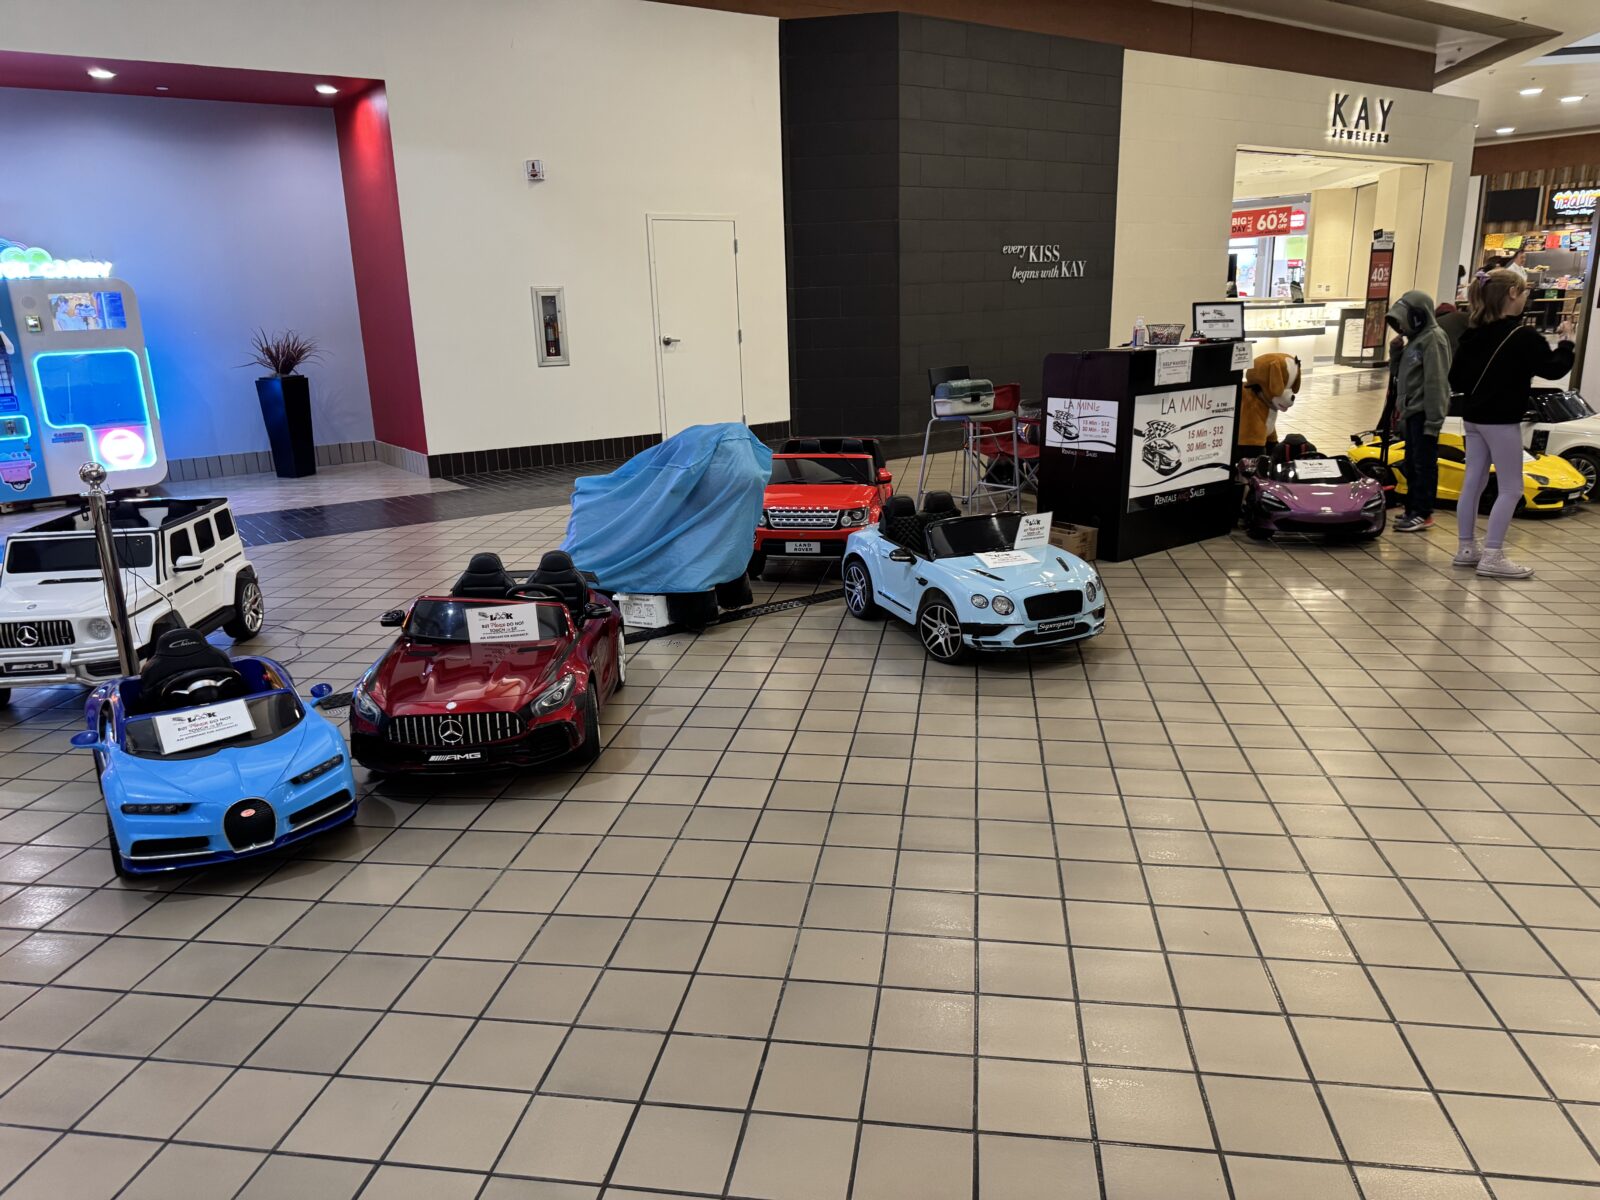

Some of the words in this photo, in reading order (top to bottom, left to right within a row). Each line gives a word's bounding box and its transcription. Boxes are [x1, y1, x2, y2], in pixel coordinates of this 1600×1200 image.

[1332, 93, 1394, 132] KAY
[1331, 129, 1389, 143] JEWELERS
[1232, 217, 1247, 225] BIG
[1232, 225, 1246, 233] DAY
[1002, 245, 1028, 258] every
[1028, 245, 1060, 263] KISS
[1012, 266, 1039, 283] begins
[1040, 265, 1059, 278] with
[1061, 260, 1087, 277] KAY
[1063, 400, 1075, 410] LA
[1161, 398, 1176, 415] LA
[1180, 393, 1213, 413] MINIs
[1188, 429, 1195, 439] 15
[1196, 428, 1208, 438] Min
[1213, 425, 1224, 436] $12
[1186, 442, 1195, 453] 30
[1195, 440, 1207, 451] Min
[1211, 438, 1223, 449] $20
[1190, 488, 1205, 498] SALES
